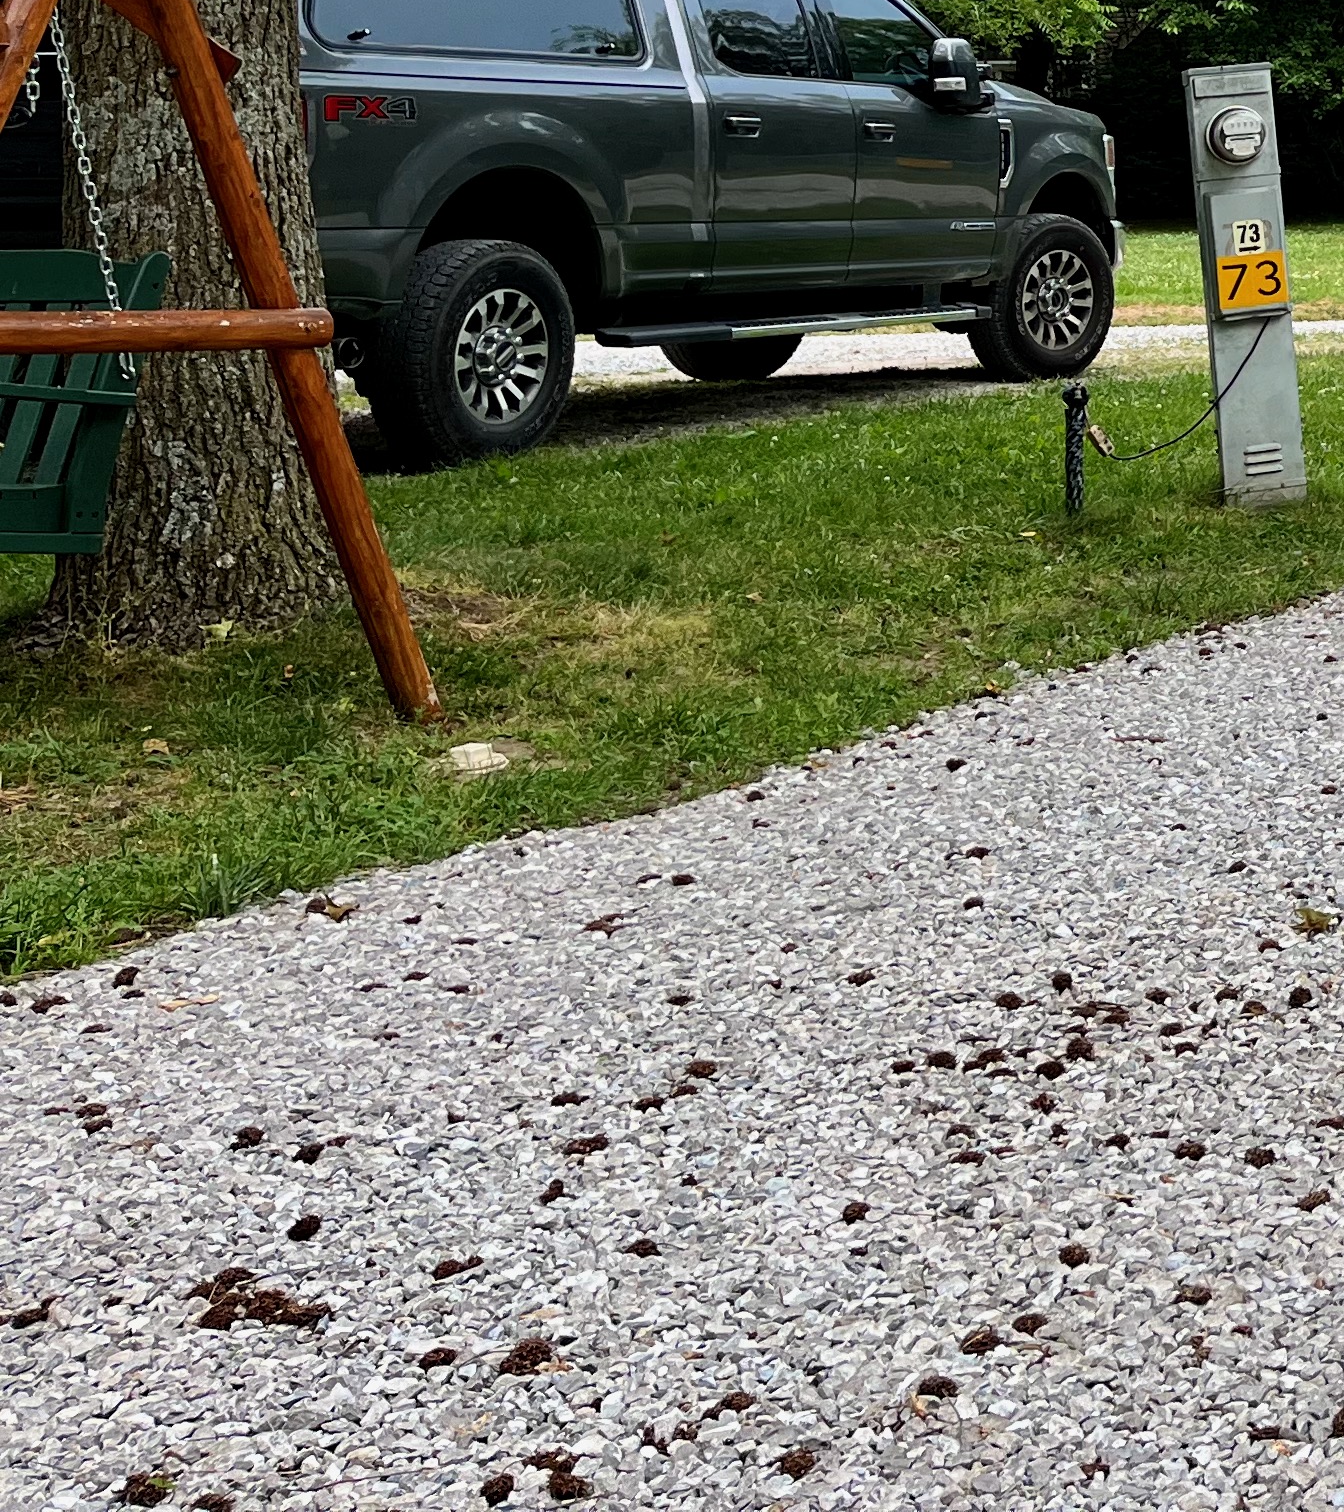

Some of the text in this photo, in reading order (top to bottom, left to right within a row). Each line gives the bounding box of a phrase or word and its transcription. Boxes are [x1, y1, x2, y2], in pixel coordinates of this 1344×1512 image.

[323, 93, 417, 123] FX4
[1236, 223, 1261, 244] 73
[1221, 260, 1282, 301] 73
